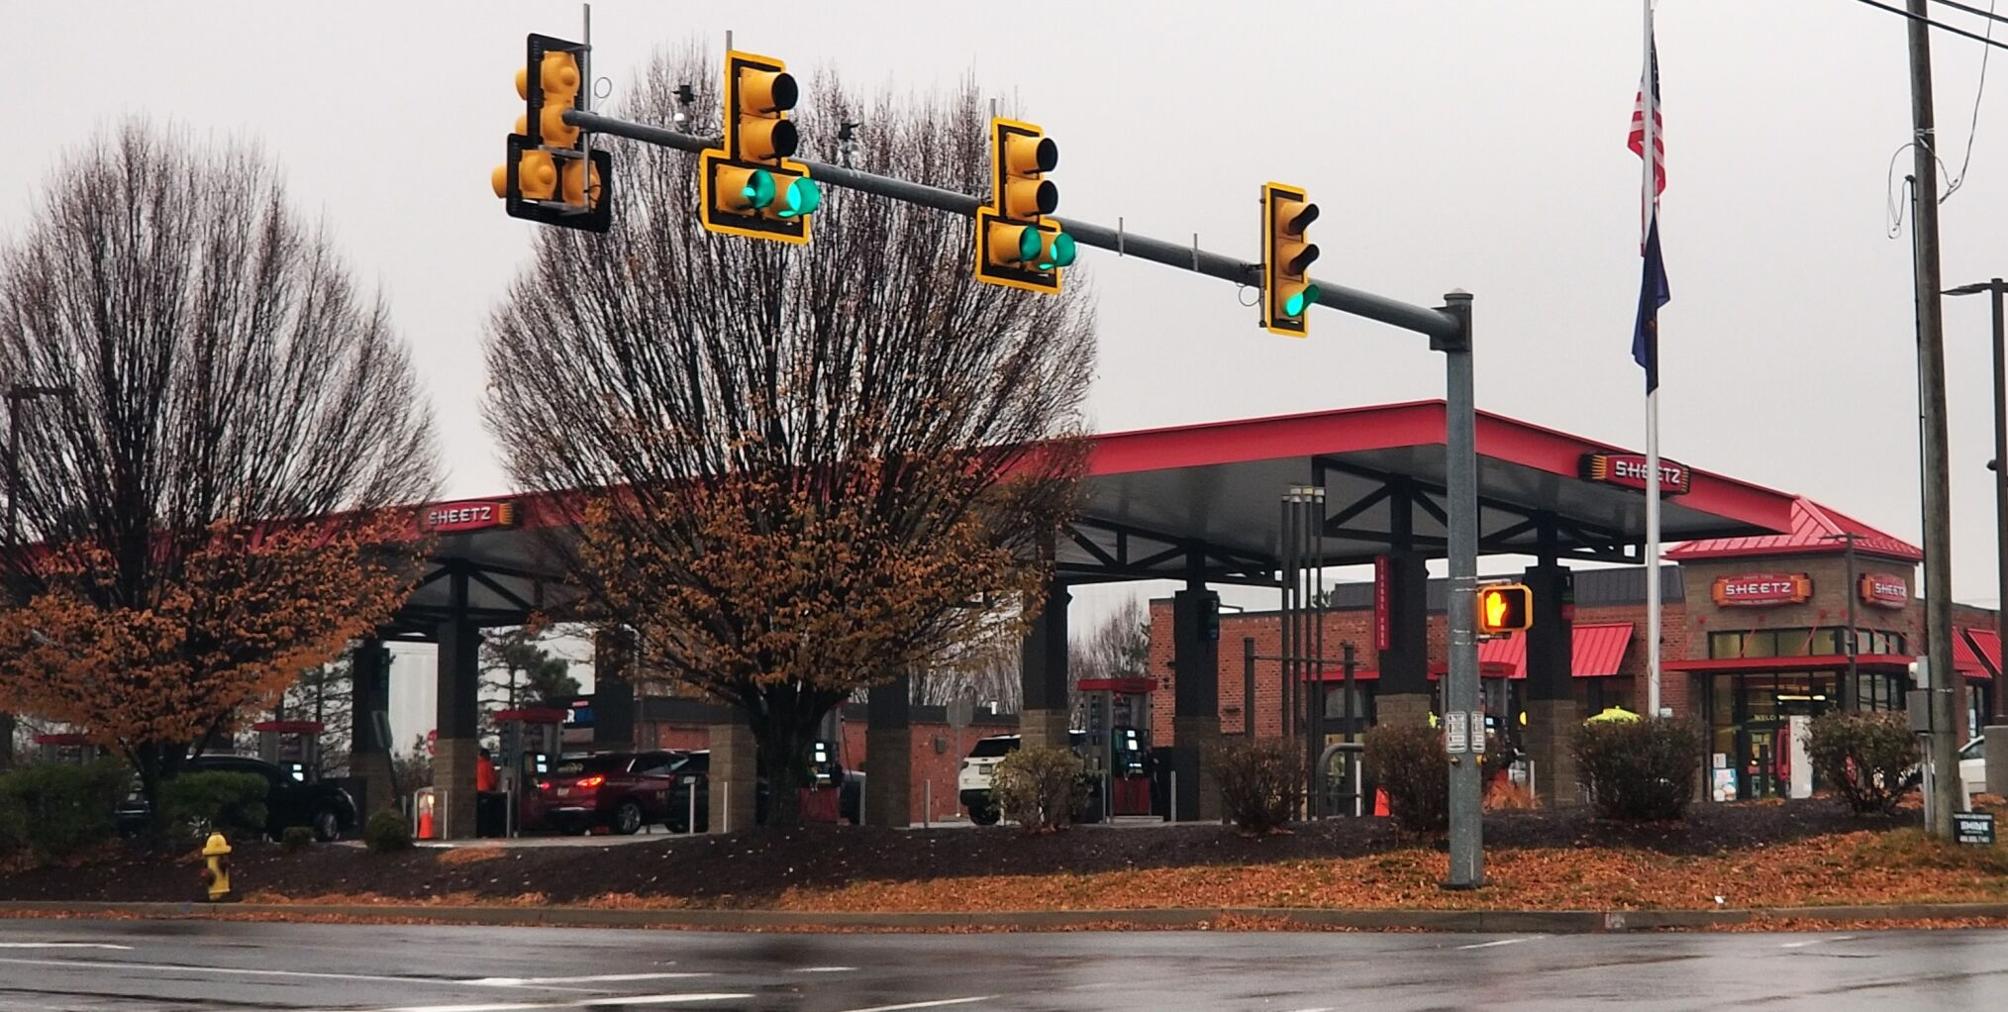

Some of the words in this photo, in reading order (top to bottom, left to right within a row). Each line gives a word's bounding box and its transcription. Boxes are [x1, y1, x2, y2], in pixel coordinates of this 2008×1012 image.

[429, 506, 491, 525] SHEETZ
[1725, 582, 1792, 595] SHEETZ
[1875, 582, 1907, 597] SHEETZ
